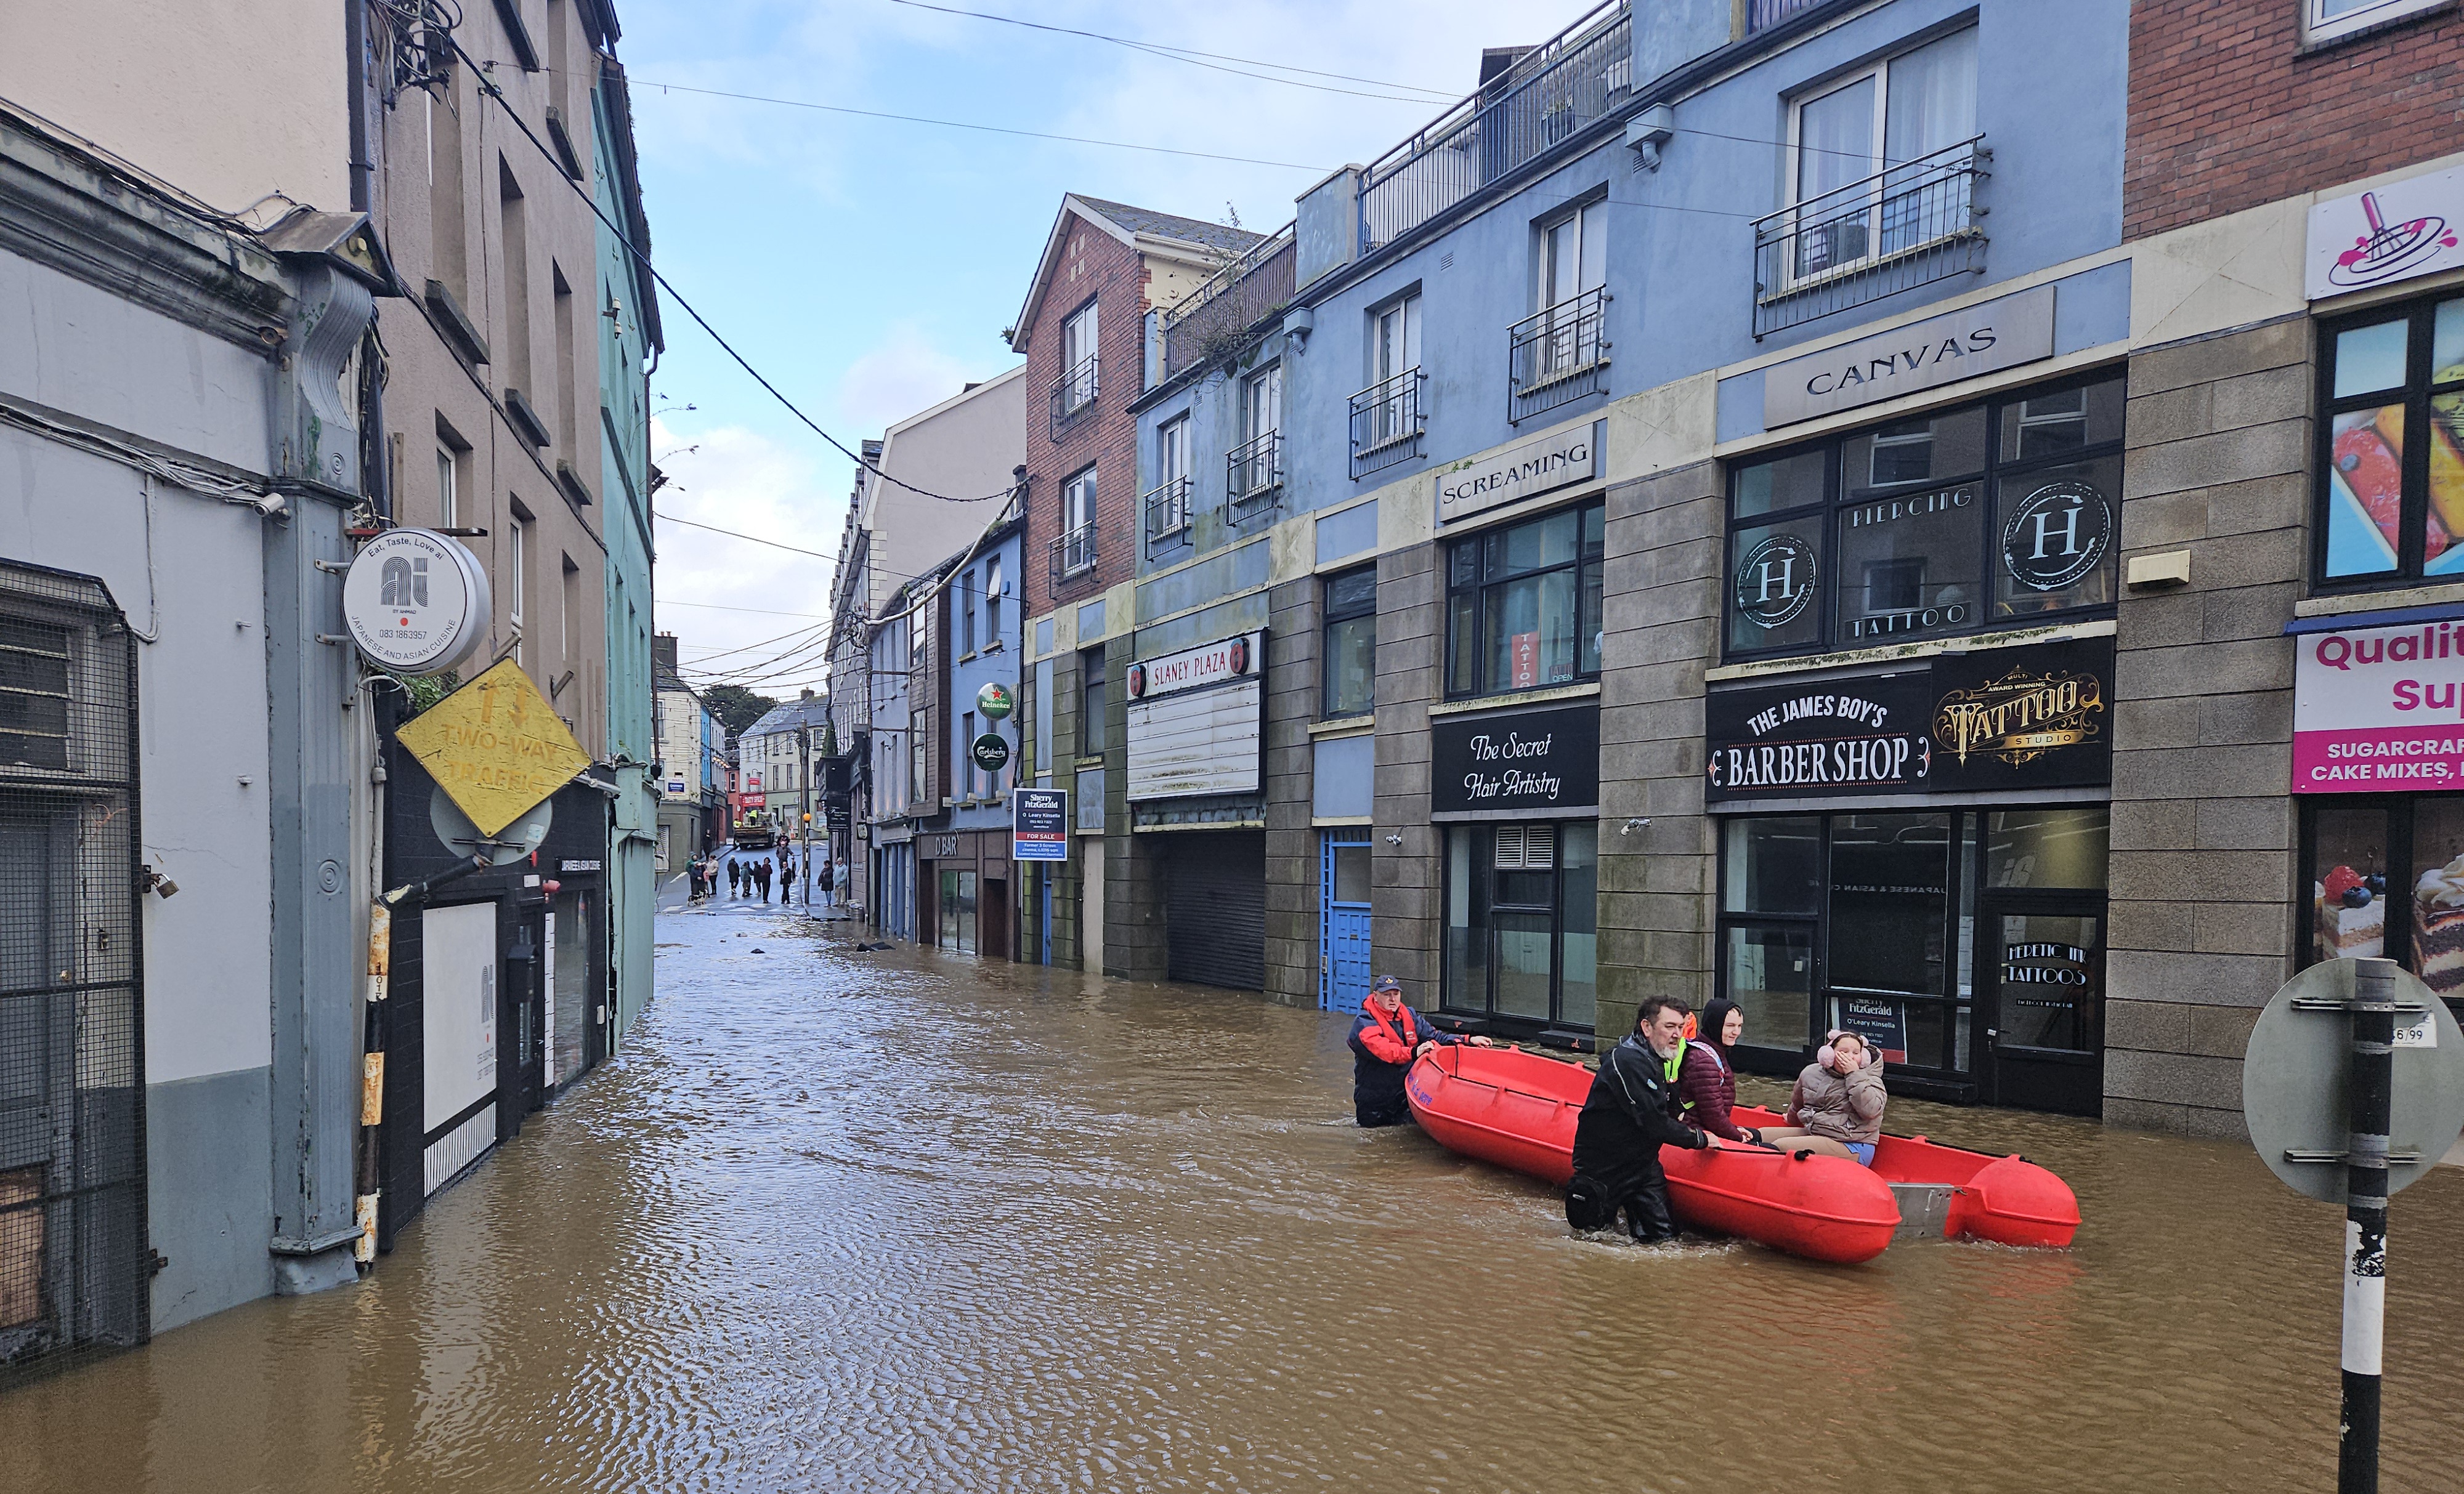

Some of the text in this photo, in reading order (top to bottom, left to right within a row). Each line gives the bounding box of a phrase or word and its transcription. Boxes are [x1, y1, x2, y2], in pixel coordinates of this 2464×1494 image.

[1806, 327, 1997, 395] CANVAS
[1443, 443, 1587, 505] SCREAMING
[1853, 488, 1971, 527] PIERCING
[2028, 506, 2084, 560] H
[368, 537, 444, 560] Eat, Taste, Love ai
[1756, 557, 1796, 603] H
[379, 629, 427, 639] 083 1863957
[1853, 605, 1964, 637] TATTOO
[352, 615, 456, 660] JAPANESE AND ASIAN CUISINE
[1154, 652, 1226, 687] SLANEY PLAZA
[1520, 634, 1531, 688] TATTOO
[2014, 681, 2046, 690] WINNING
[981, 701, 1010, 709] Heineken
[1747, 695, 1888, 737] THE JAMES BOY'S
[441, 724, 557, 761] TWO-WAY
[976, 746, 1006, 758] Carlsberg
[1470, 732, 1552, 761] The Secret
[2016, 734, 2072, 745] STUDIO
[446, 760, 545, 793] TRAFFIC
[1727, 738, 1908, 786] BARBER SHOP
[2311, 764, 2371, 781] CAKE
[2377, 762, 2454, 780] MIXES,
[1030, 794, 1052, 802] Sherry
[1464, 769, 1560, 801] Hair Artistry
[1024, 801, 1058, 809] FitzGerald
[936, 836, 957, 855] D BAR
[2009, 944, 2062, 961] HERETIC
[2008, 966, 2086, 985] TATTOOS
[1847, 1018, 1895, 1028] O'Leary Kinsella
[1849, 1003, 1892, 1016] FitzGerald
